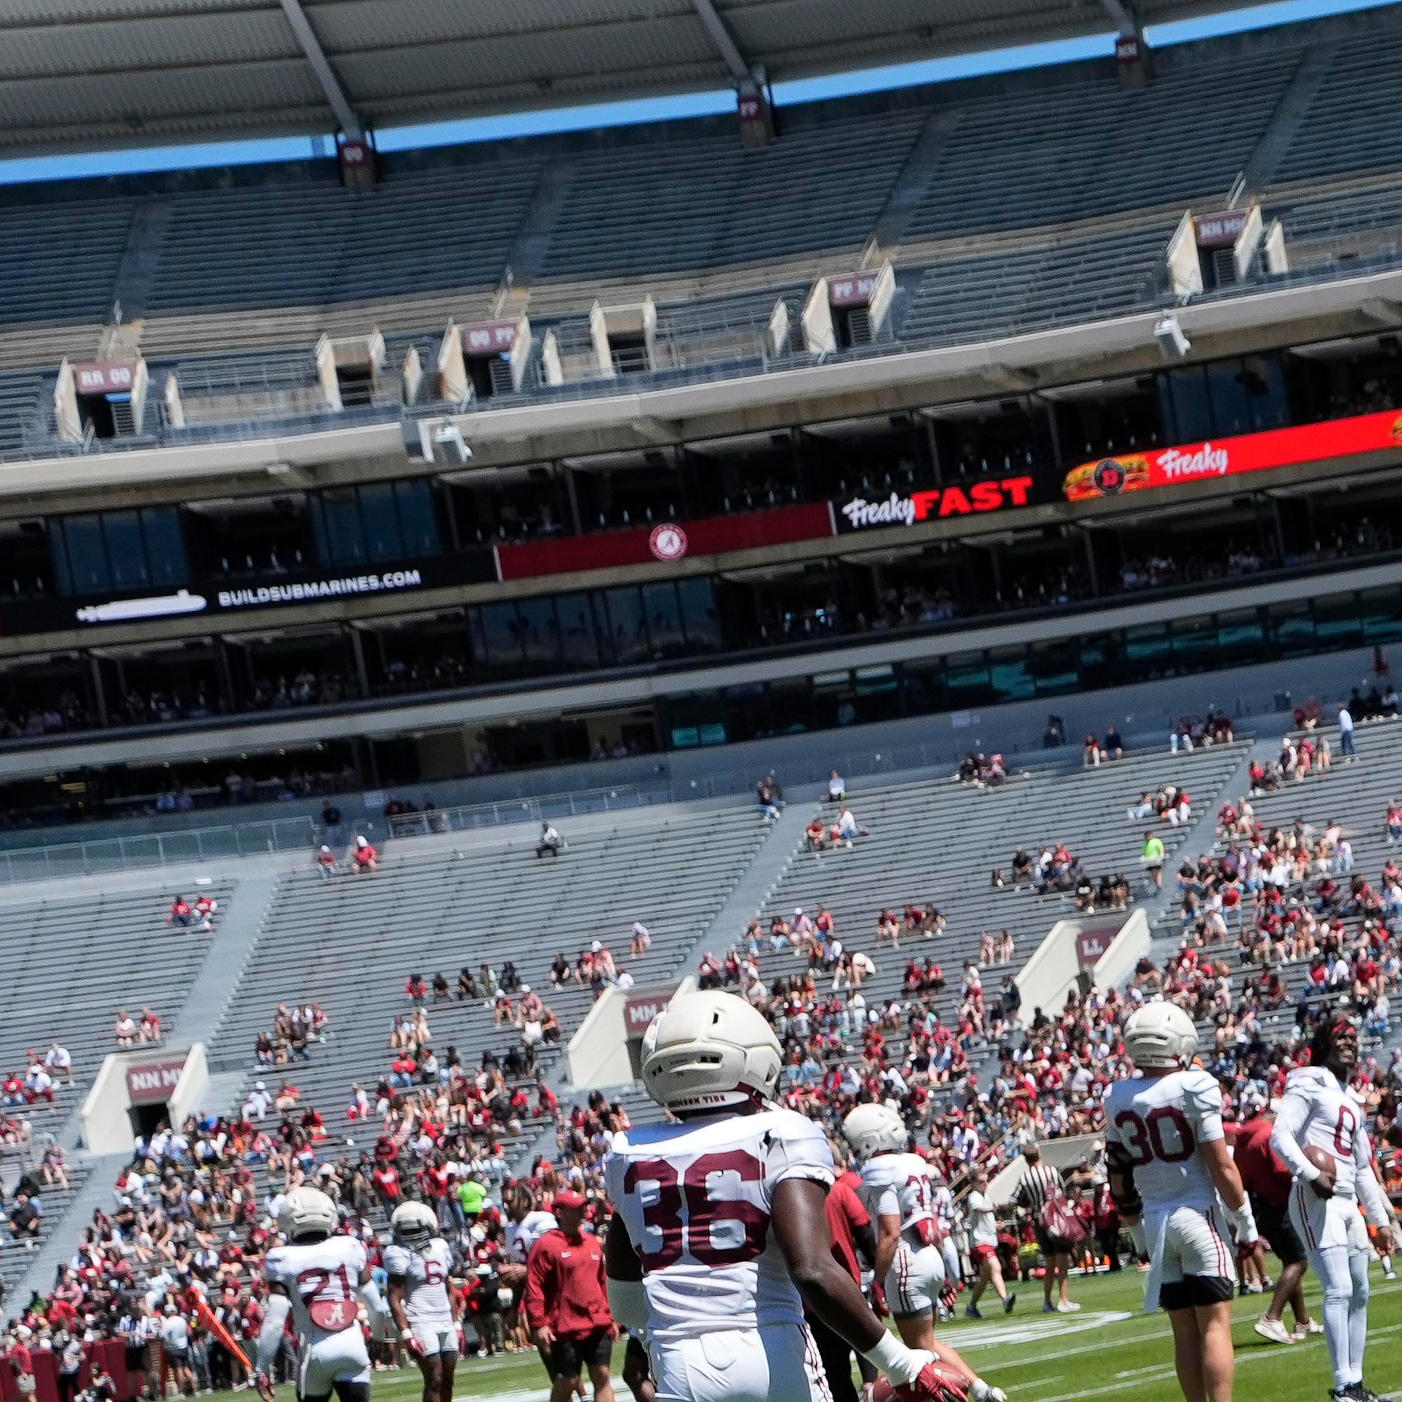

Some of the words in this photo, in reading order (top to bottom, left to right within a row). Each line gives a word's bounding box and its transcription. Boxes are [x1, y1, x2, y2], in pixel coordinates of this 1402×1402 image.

[1156, 442, 1229, 479] Freaky
[217, 569, 422, 607] BUILDSUBMARINES.COM
[162, 1068, 182, 1088] M
[1114, 1105, 1196, 1166] 30
[1333, 1104, 1356, 1157] 0
[624, 1149, 771, 1277] 36
[297, 1264, 350, 1306] 21
[424, 1260, 443, 1286] 6
